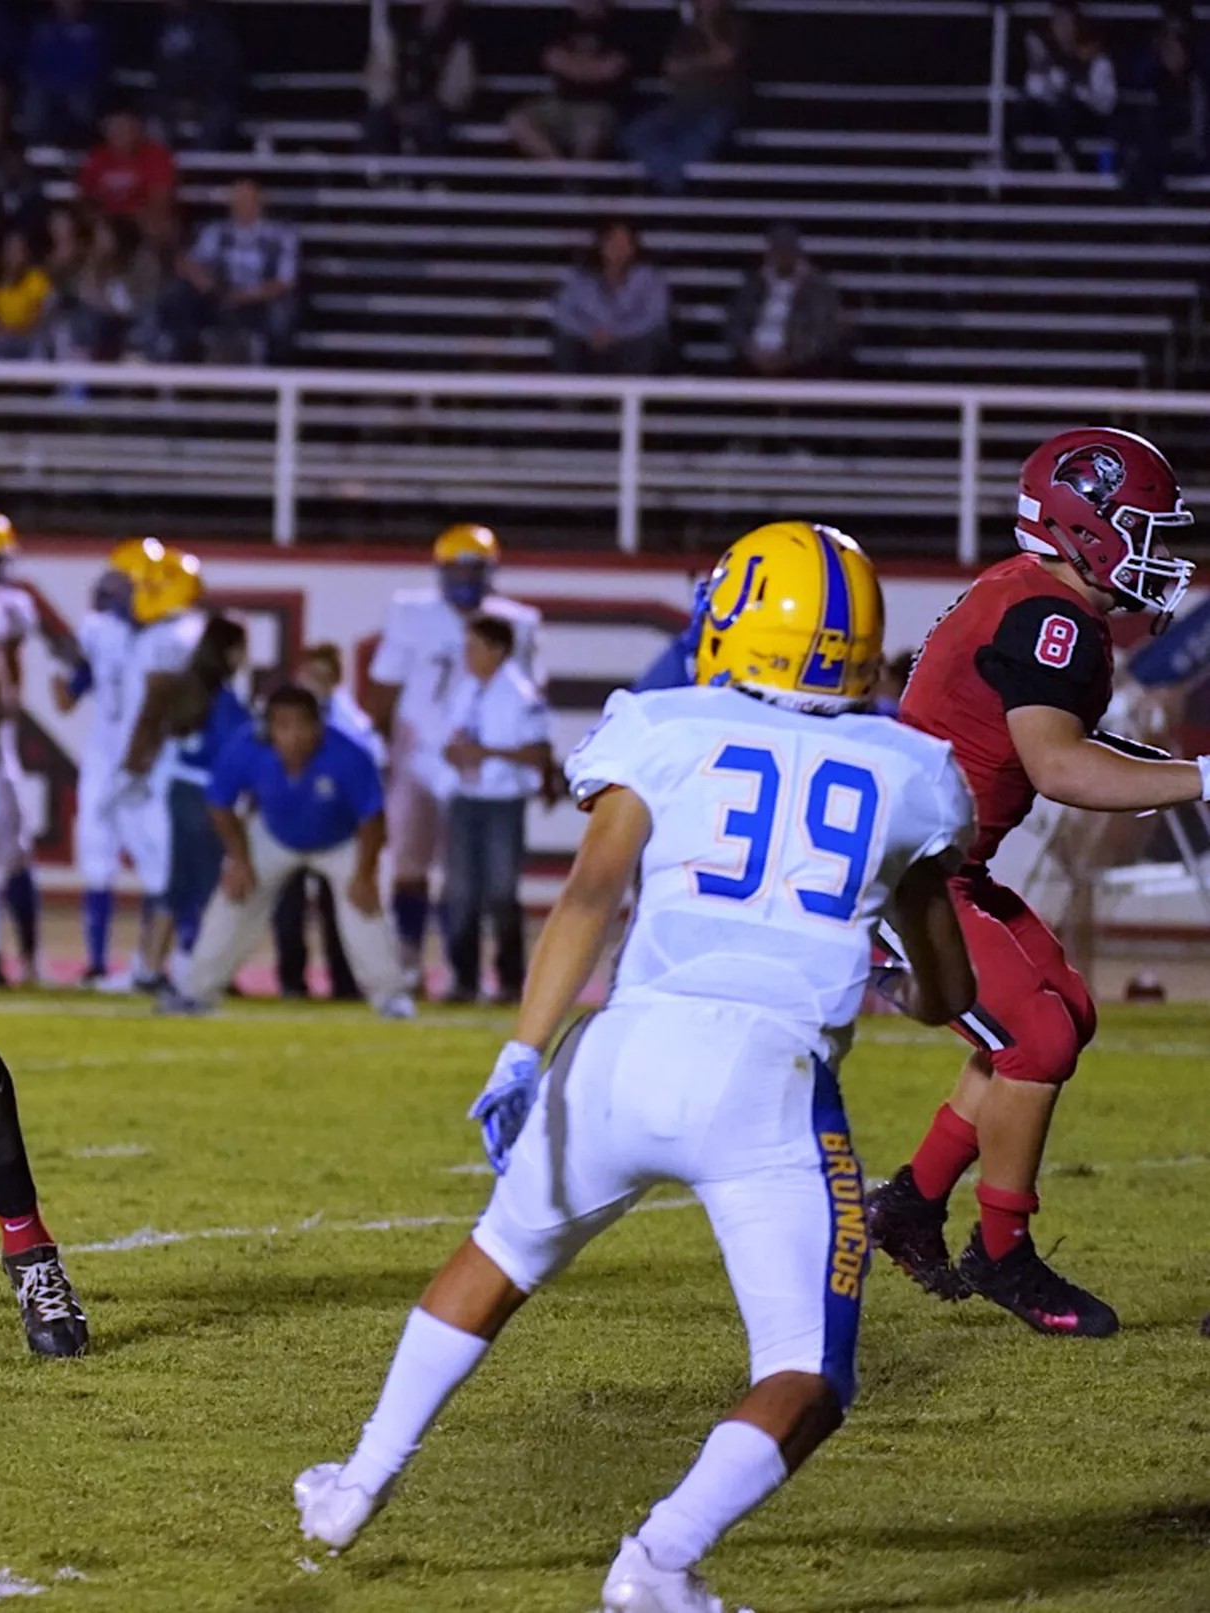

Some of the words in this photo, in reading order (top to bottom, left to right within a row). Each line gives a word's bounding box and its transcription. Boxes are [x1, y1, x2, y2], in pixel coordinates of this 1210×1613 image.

[1034, 614, 1078, 669] 8
[688, 738, 882, 928] 39
[819, 1131, 869, 1300] BRONCOS
